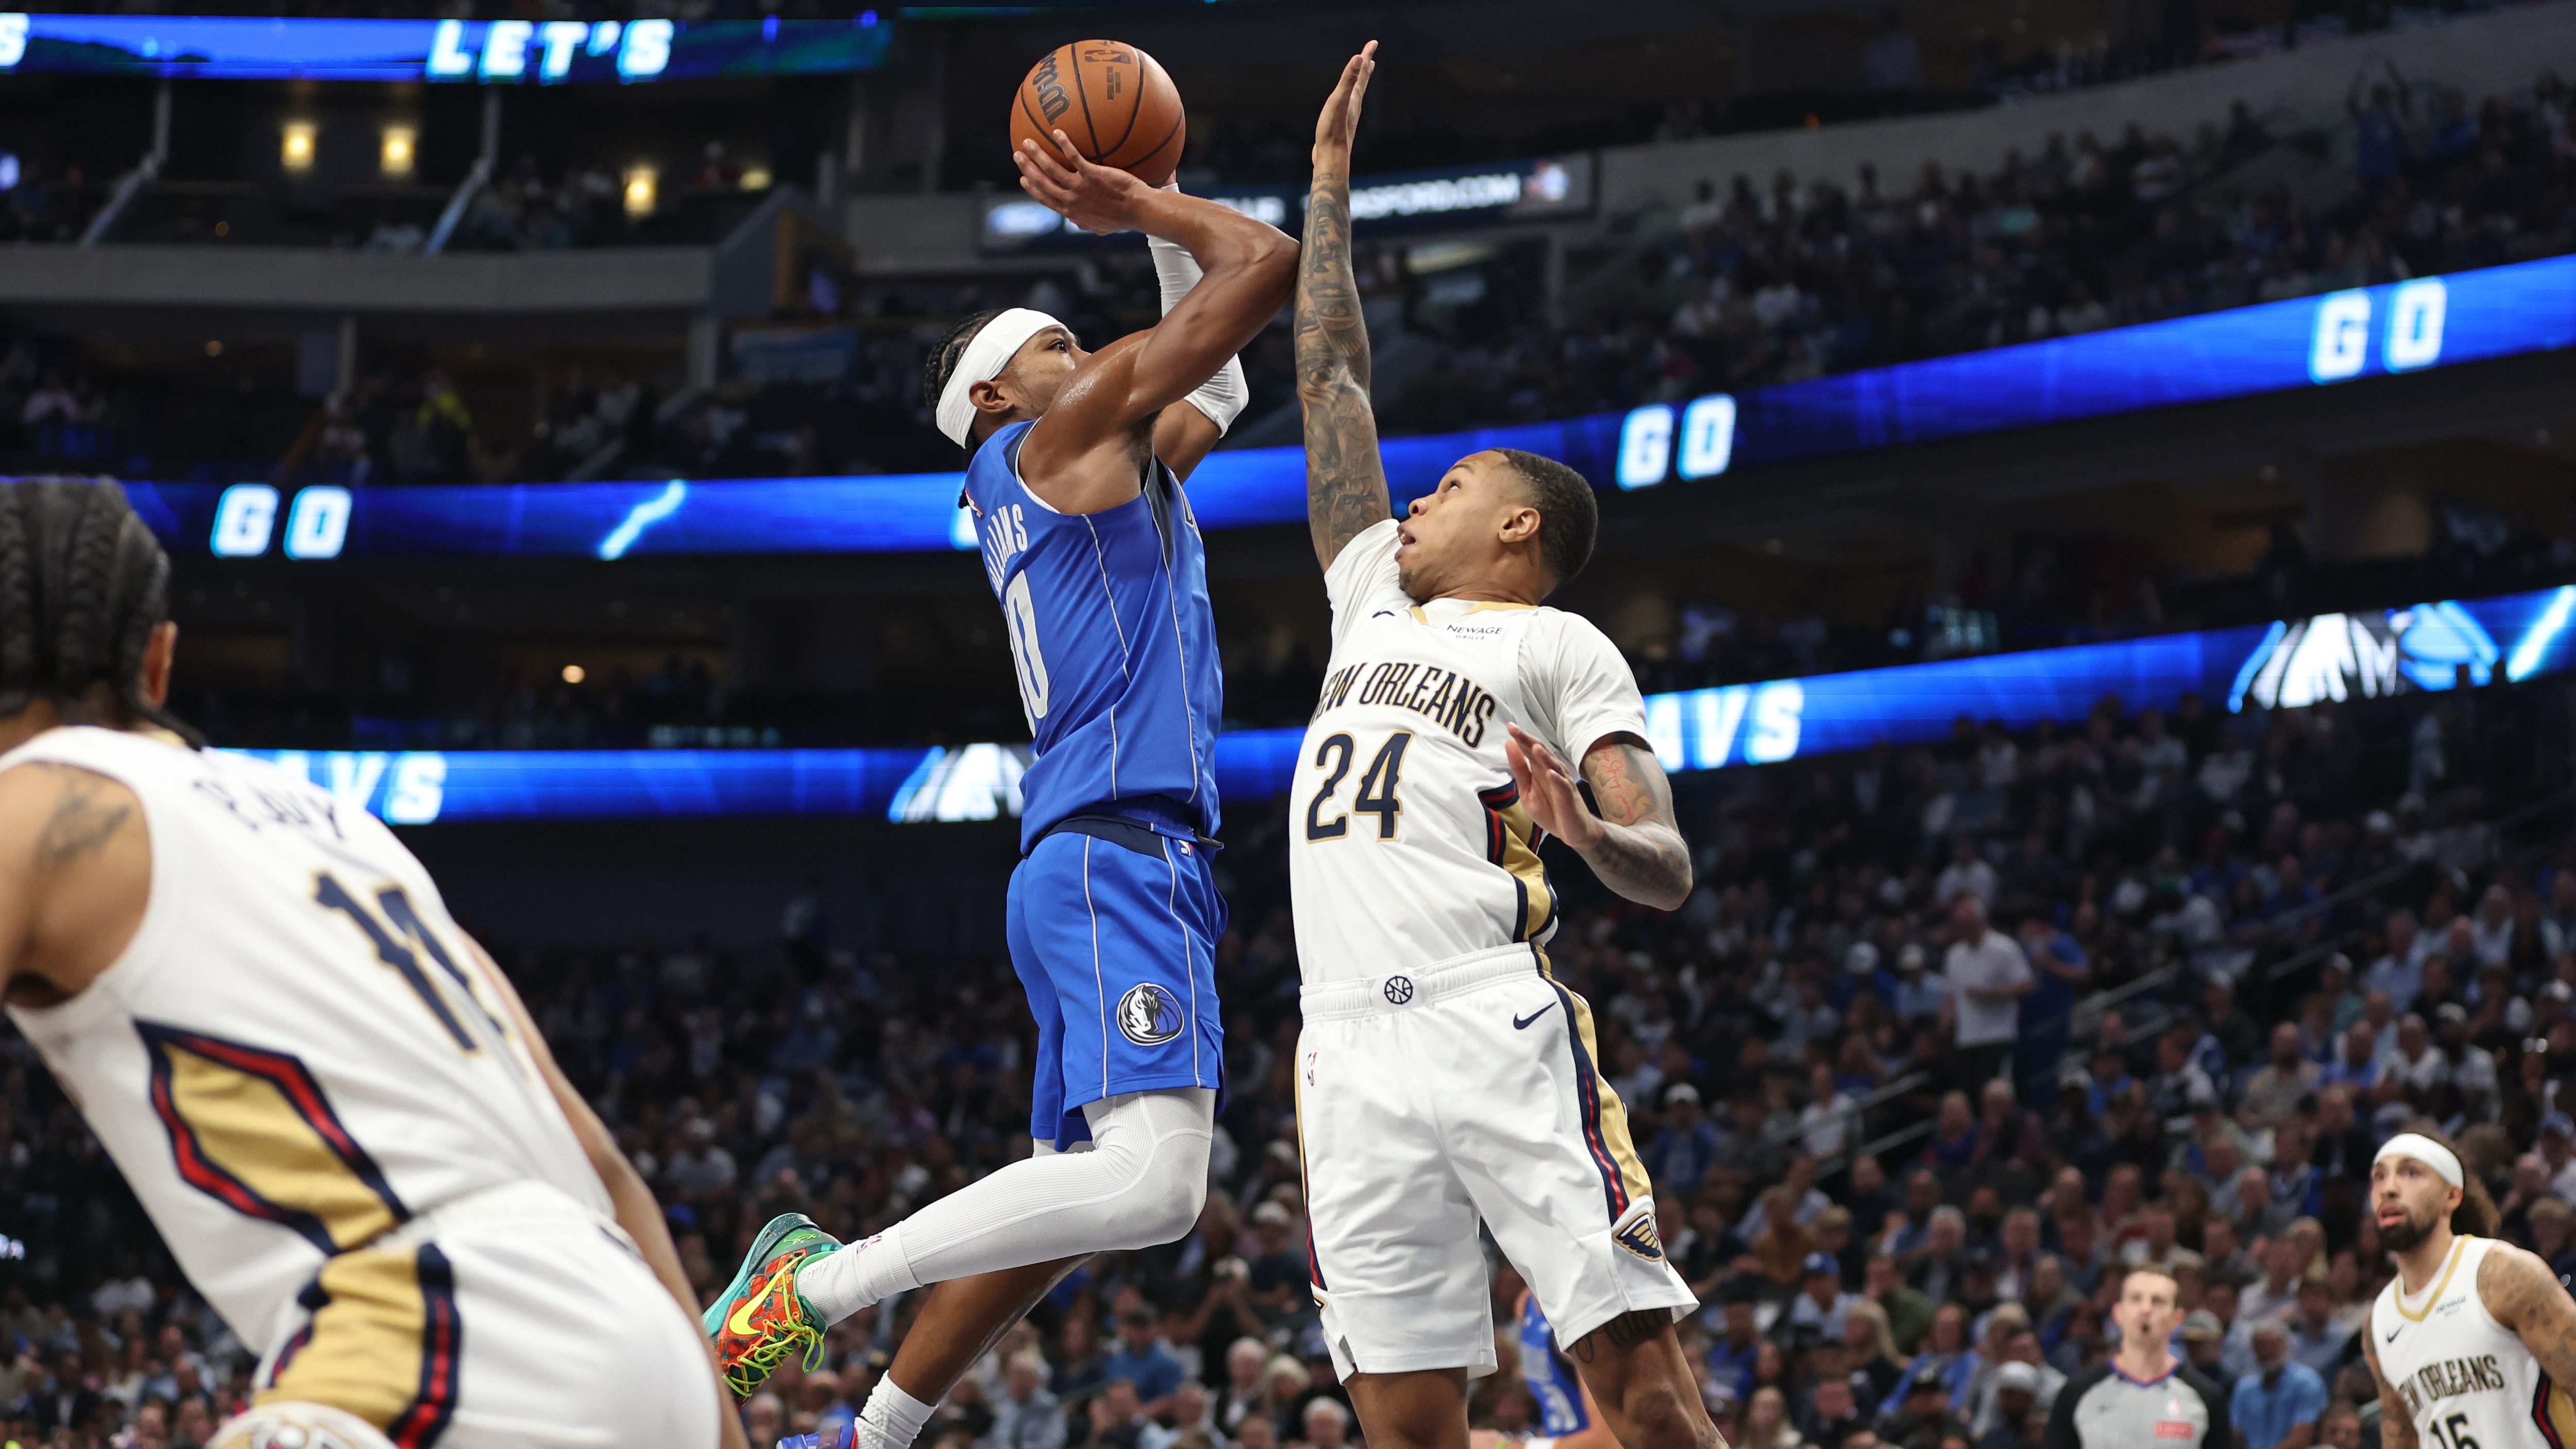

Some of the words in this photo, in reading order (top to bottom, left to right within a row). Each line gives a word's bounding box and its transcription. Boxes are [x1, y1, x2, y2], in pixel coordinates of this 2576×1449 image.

[428, 19, 674, 77] LET'S
[2311, 279, 2448, 379] GO
[1619, 397, 1736, 488] GO
[212, 485, 352, 559] GO
[1003, 569, 1049, 739] 0
[1358, 662, 1497, 750] ORLEANS
[1306, 729, 1415, 845] 24
[2418, 1354, 2505, 1402] ORLEANS
